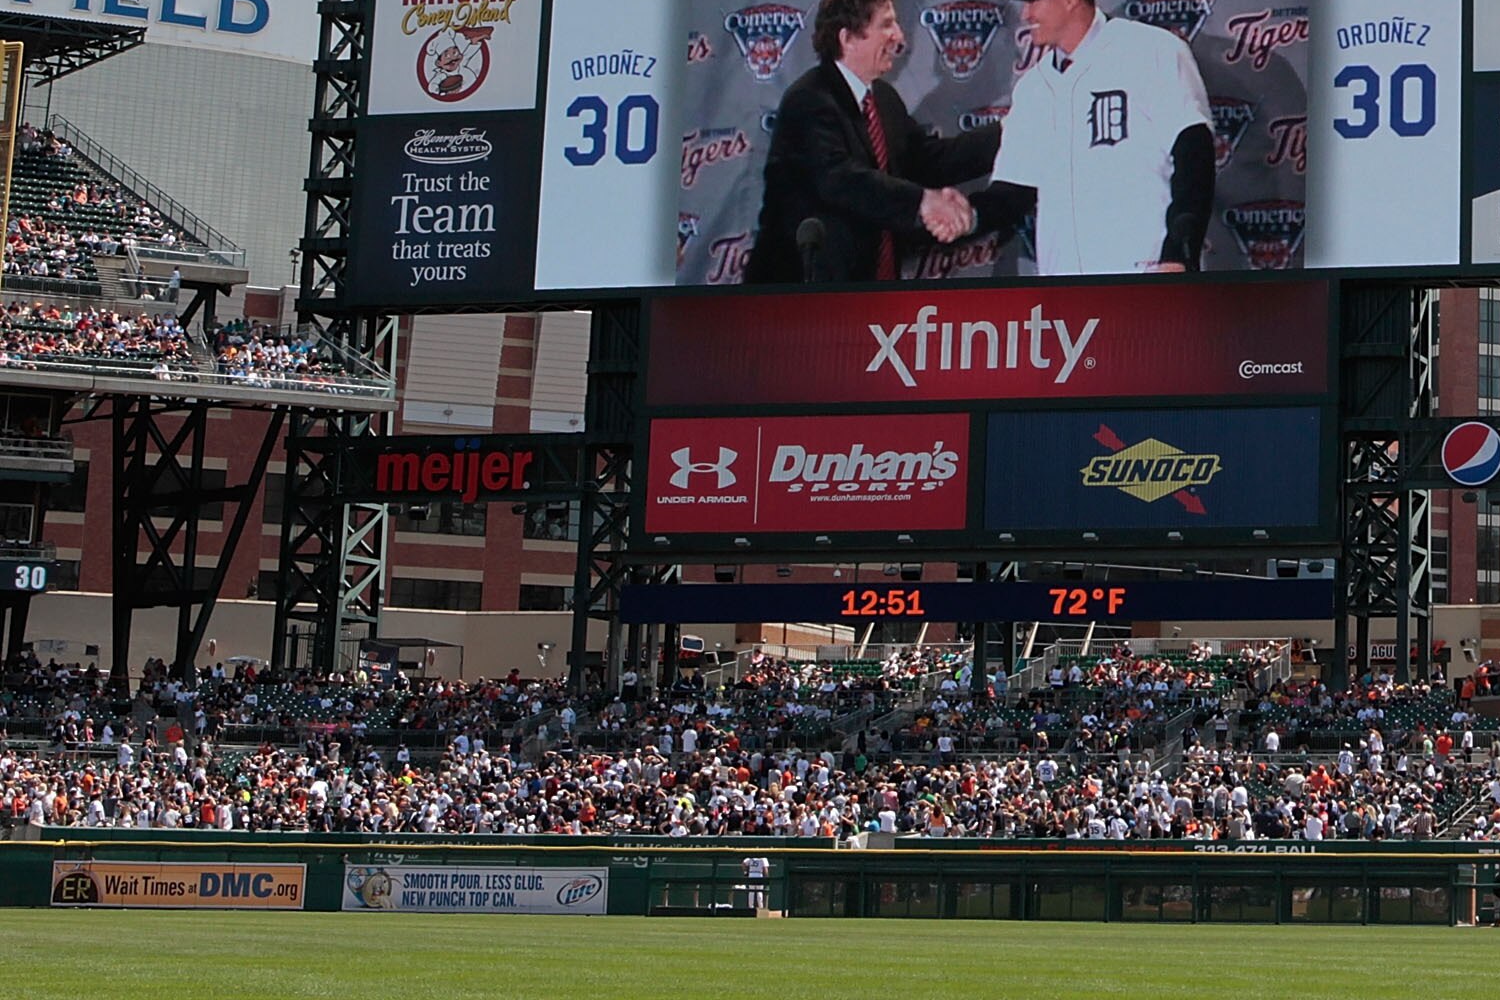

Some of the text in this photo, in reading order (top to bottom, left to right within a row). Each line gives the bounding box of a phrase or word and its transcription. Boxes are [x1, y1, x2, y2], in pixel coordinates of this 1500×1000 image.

[401, 3, 452, 35] Coney
[1337, 16, 1431, 49] ORDOÑEZ
[571, 50, 656, 81] ORDOÑEZ
[1333, 64, 1436, 139] 30
[413, 128, 487, 148] Henry Ford
[564, 95, 660, 166] 30
[410, 145, 488, 154] HEALTH SYSTEM
[402, 171, 490, 193] Trust the
[391, 194, 496, 234] Team
[392, 239, 491, 259] that treats
[410, 265, 467, 286] yours
[866, 304, 1100, 387] xfinity
[376, 438, 533, 503] meijer
[769, 441, 959, 482] Dunham's
[1088, 457, 1215, 483] SUNOCO
[787, 481, 938, 492] SPORTS
[657, 495, 747, 504] UNDER ARMOUR
[15, 566, 46, 589] 30
[840, 590, 925, 615] 12:51
[62, 878, 91, 899] ER
[105, 872, 298, 901] Wait Times at DMC.org
[403, 873, 545, 891] SMOOTH POUR. LESS GLUG.
[402, 891, 517, 907] NEW PUNCH TOP CAN.
